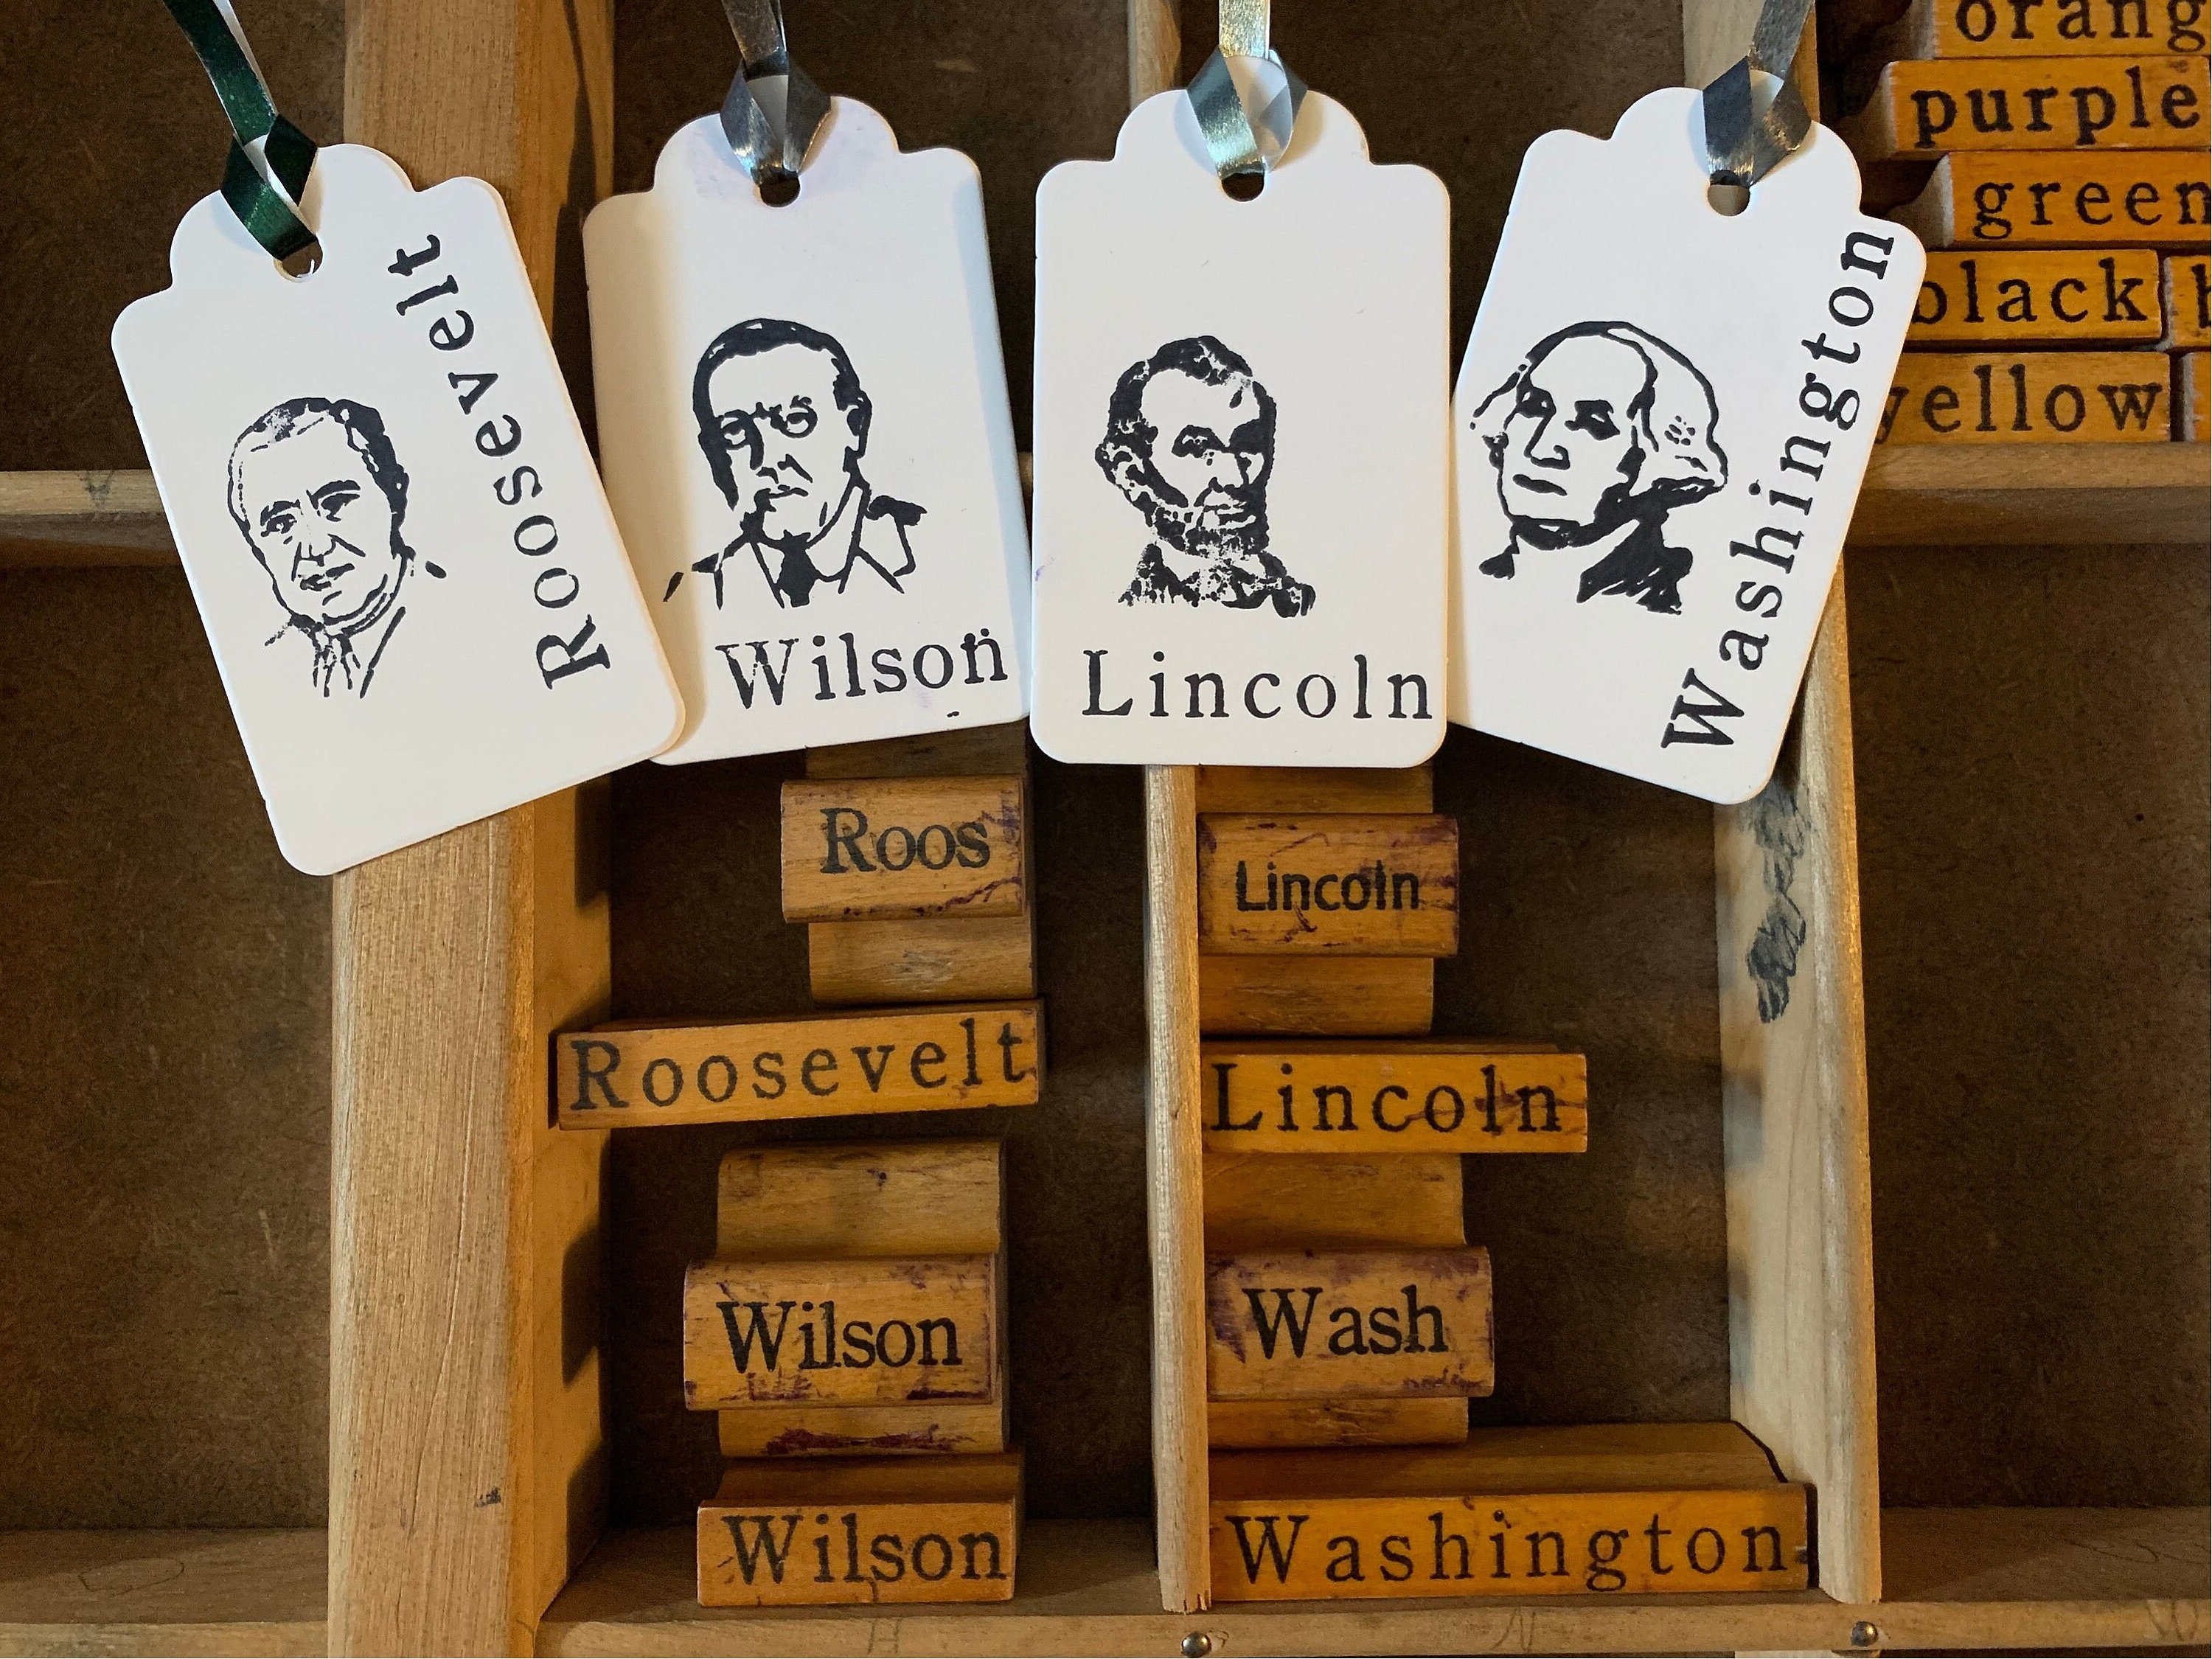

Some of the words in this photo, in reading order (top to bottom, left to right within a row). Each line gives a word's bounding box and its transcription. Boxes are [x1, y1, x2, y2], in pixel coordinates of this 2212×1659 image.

[1910, 66, 2200, 147] purple
[1972, 182, 2211, 240] green
[388, 234, 611, 689] Roosevelt
[1661, 231, 1894, 748] Washington
[715, 628, 1009, 709] Wilson
[1082, 650, 1433, 720] Lincoln
[820, 807, 990, 874] Roos
[1235, 860, 1420, 912] Lincoln
[569, 1018, 1031, 1110] Roosevelt
[1209, 1062, 1562, 1133] Lincoln
[716, 1300, 963, 1374] Wilson
[1242, 1284, 1449, 1360] Wash
[721, 1512, 1007, 1585] Wilson
[1224, 1512, 1787, 1592] Washington
